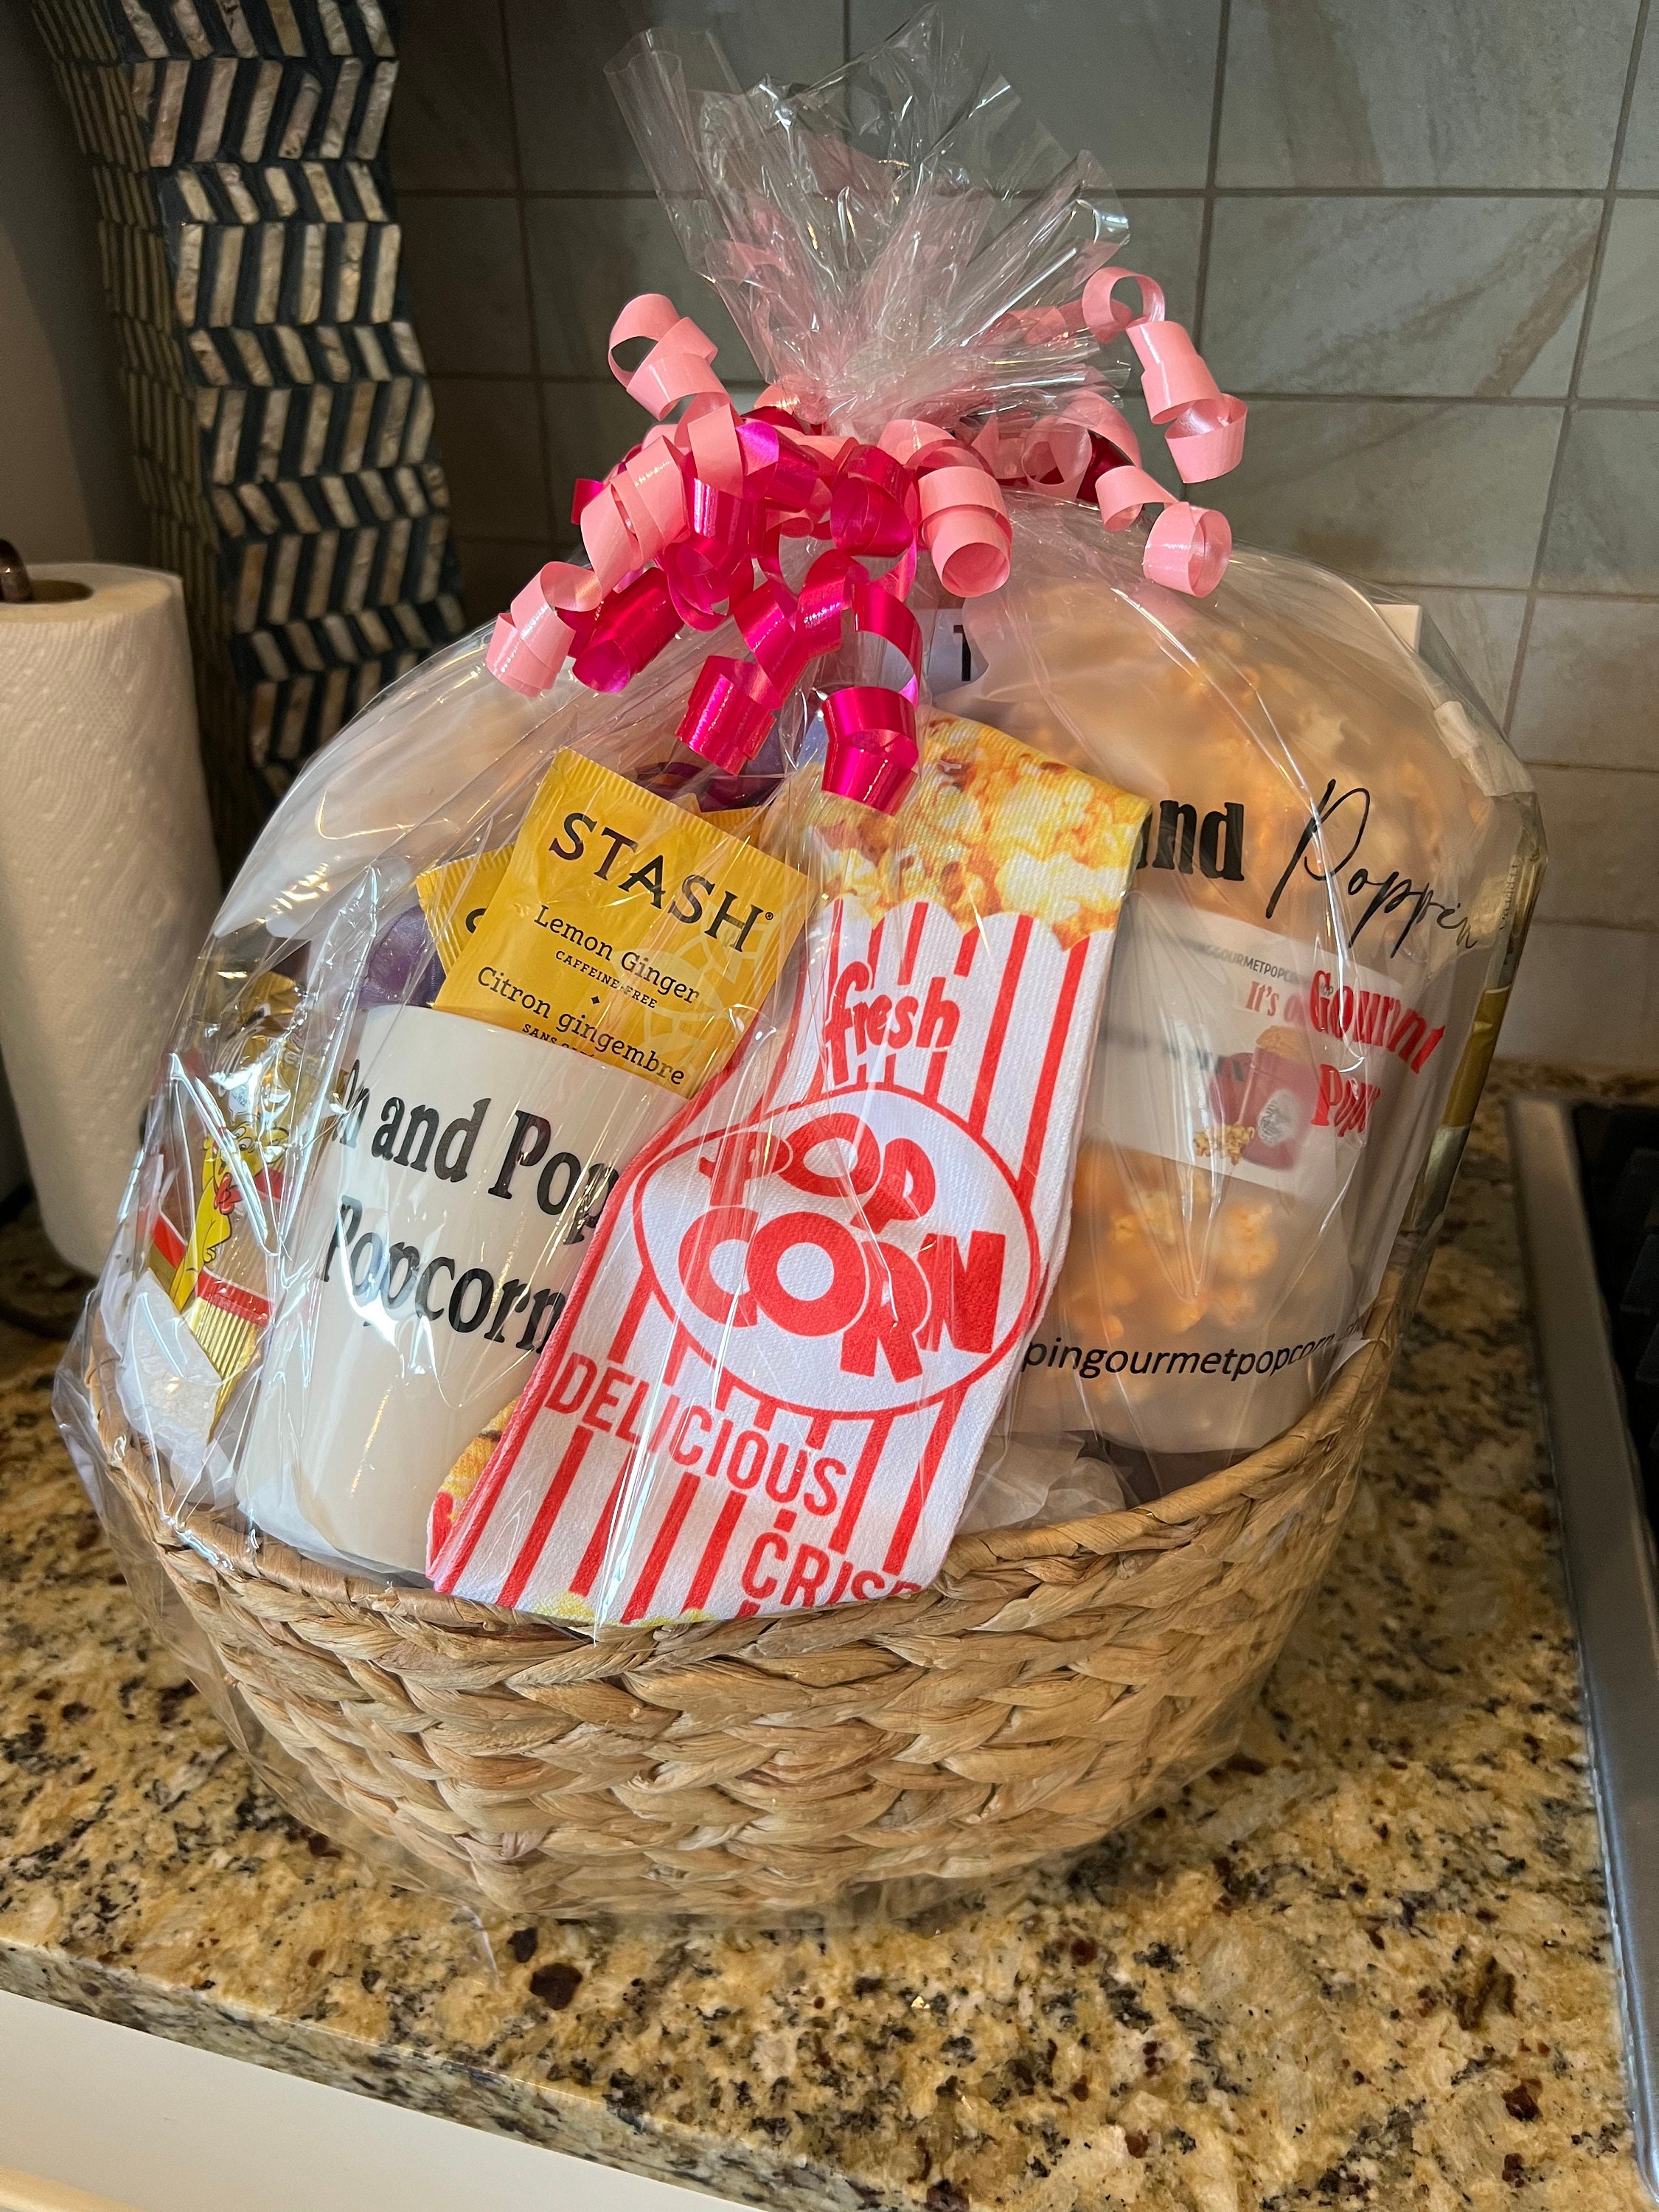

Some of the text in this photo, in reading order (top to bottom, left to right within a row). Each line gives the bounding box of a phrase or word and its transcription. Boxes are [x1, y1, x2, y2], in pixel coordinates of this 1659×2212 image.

[533, 905, 613, 961] Lemon
[622, 951, 700, 1004] Ginger
[477, 966, 684, 1085] Citron gingembre
[522, 1023, 557, 1044] SANS
[825, 961, 960, 1085] fresh
[371, 1097, 491, 1183] and
[698, 1113, 936, 1234] POP
[323, 1194, 566, 1354] Popcorn
[678, 1206, 1006, 1384] CORN
[545, 1353, 846, 1516] DELICIOUS
